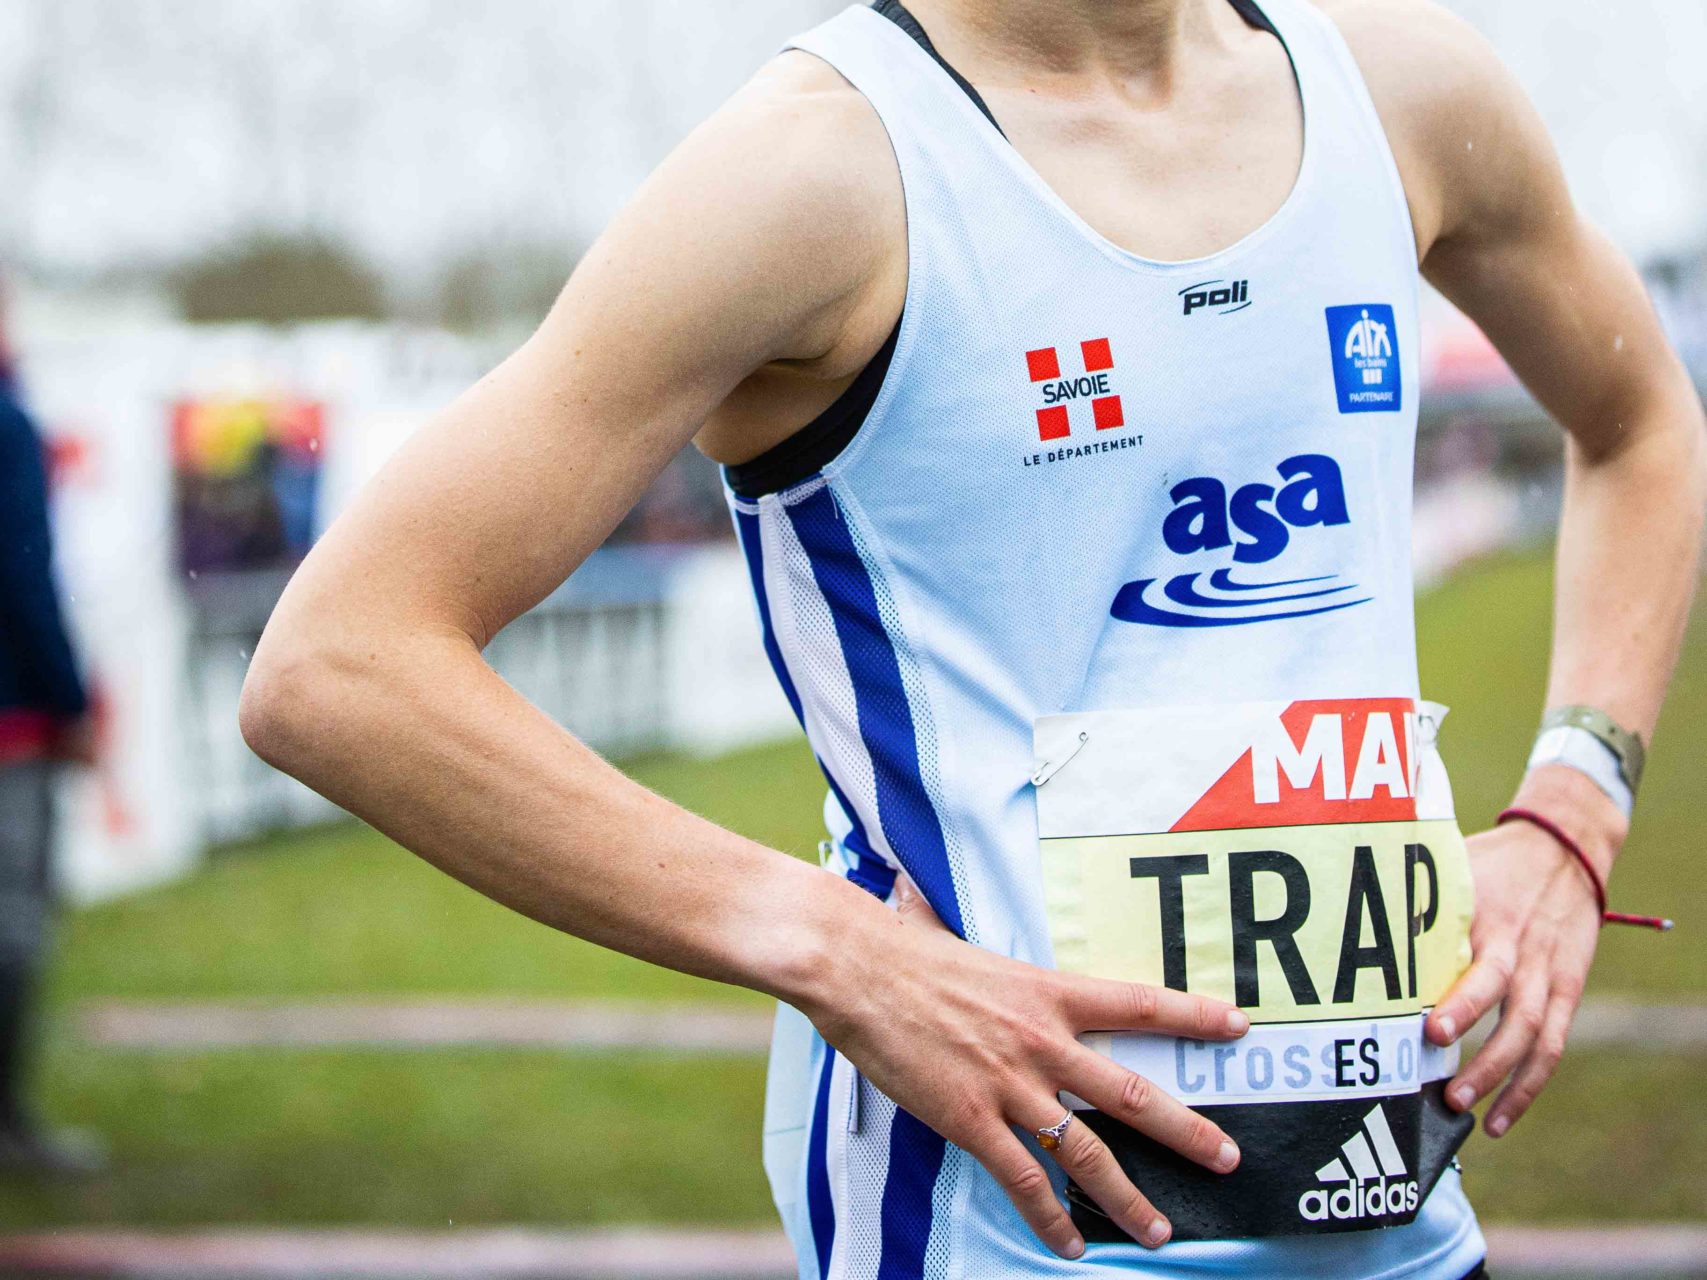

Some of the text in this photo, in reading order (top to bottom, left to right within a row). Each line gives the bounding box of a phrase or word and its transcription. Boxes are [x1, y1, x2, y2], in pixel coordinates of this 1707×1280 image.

[1183, 280, 1249, 316] poli
[1042, 373, 1111, 404] SAVOIE
[1023, 435, 1145, 467] LE DÉPARTEMENT
[1162, 454, 1351, 564] asa
[1250, 712, 1416, 805] MA
[1129, 843, 1439, 1008] TRAP
[1334, 1037, 1381, 1088] ES
[1298, 1176, 1419, 1221] adidas
